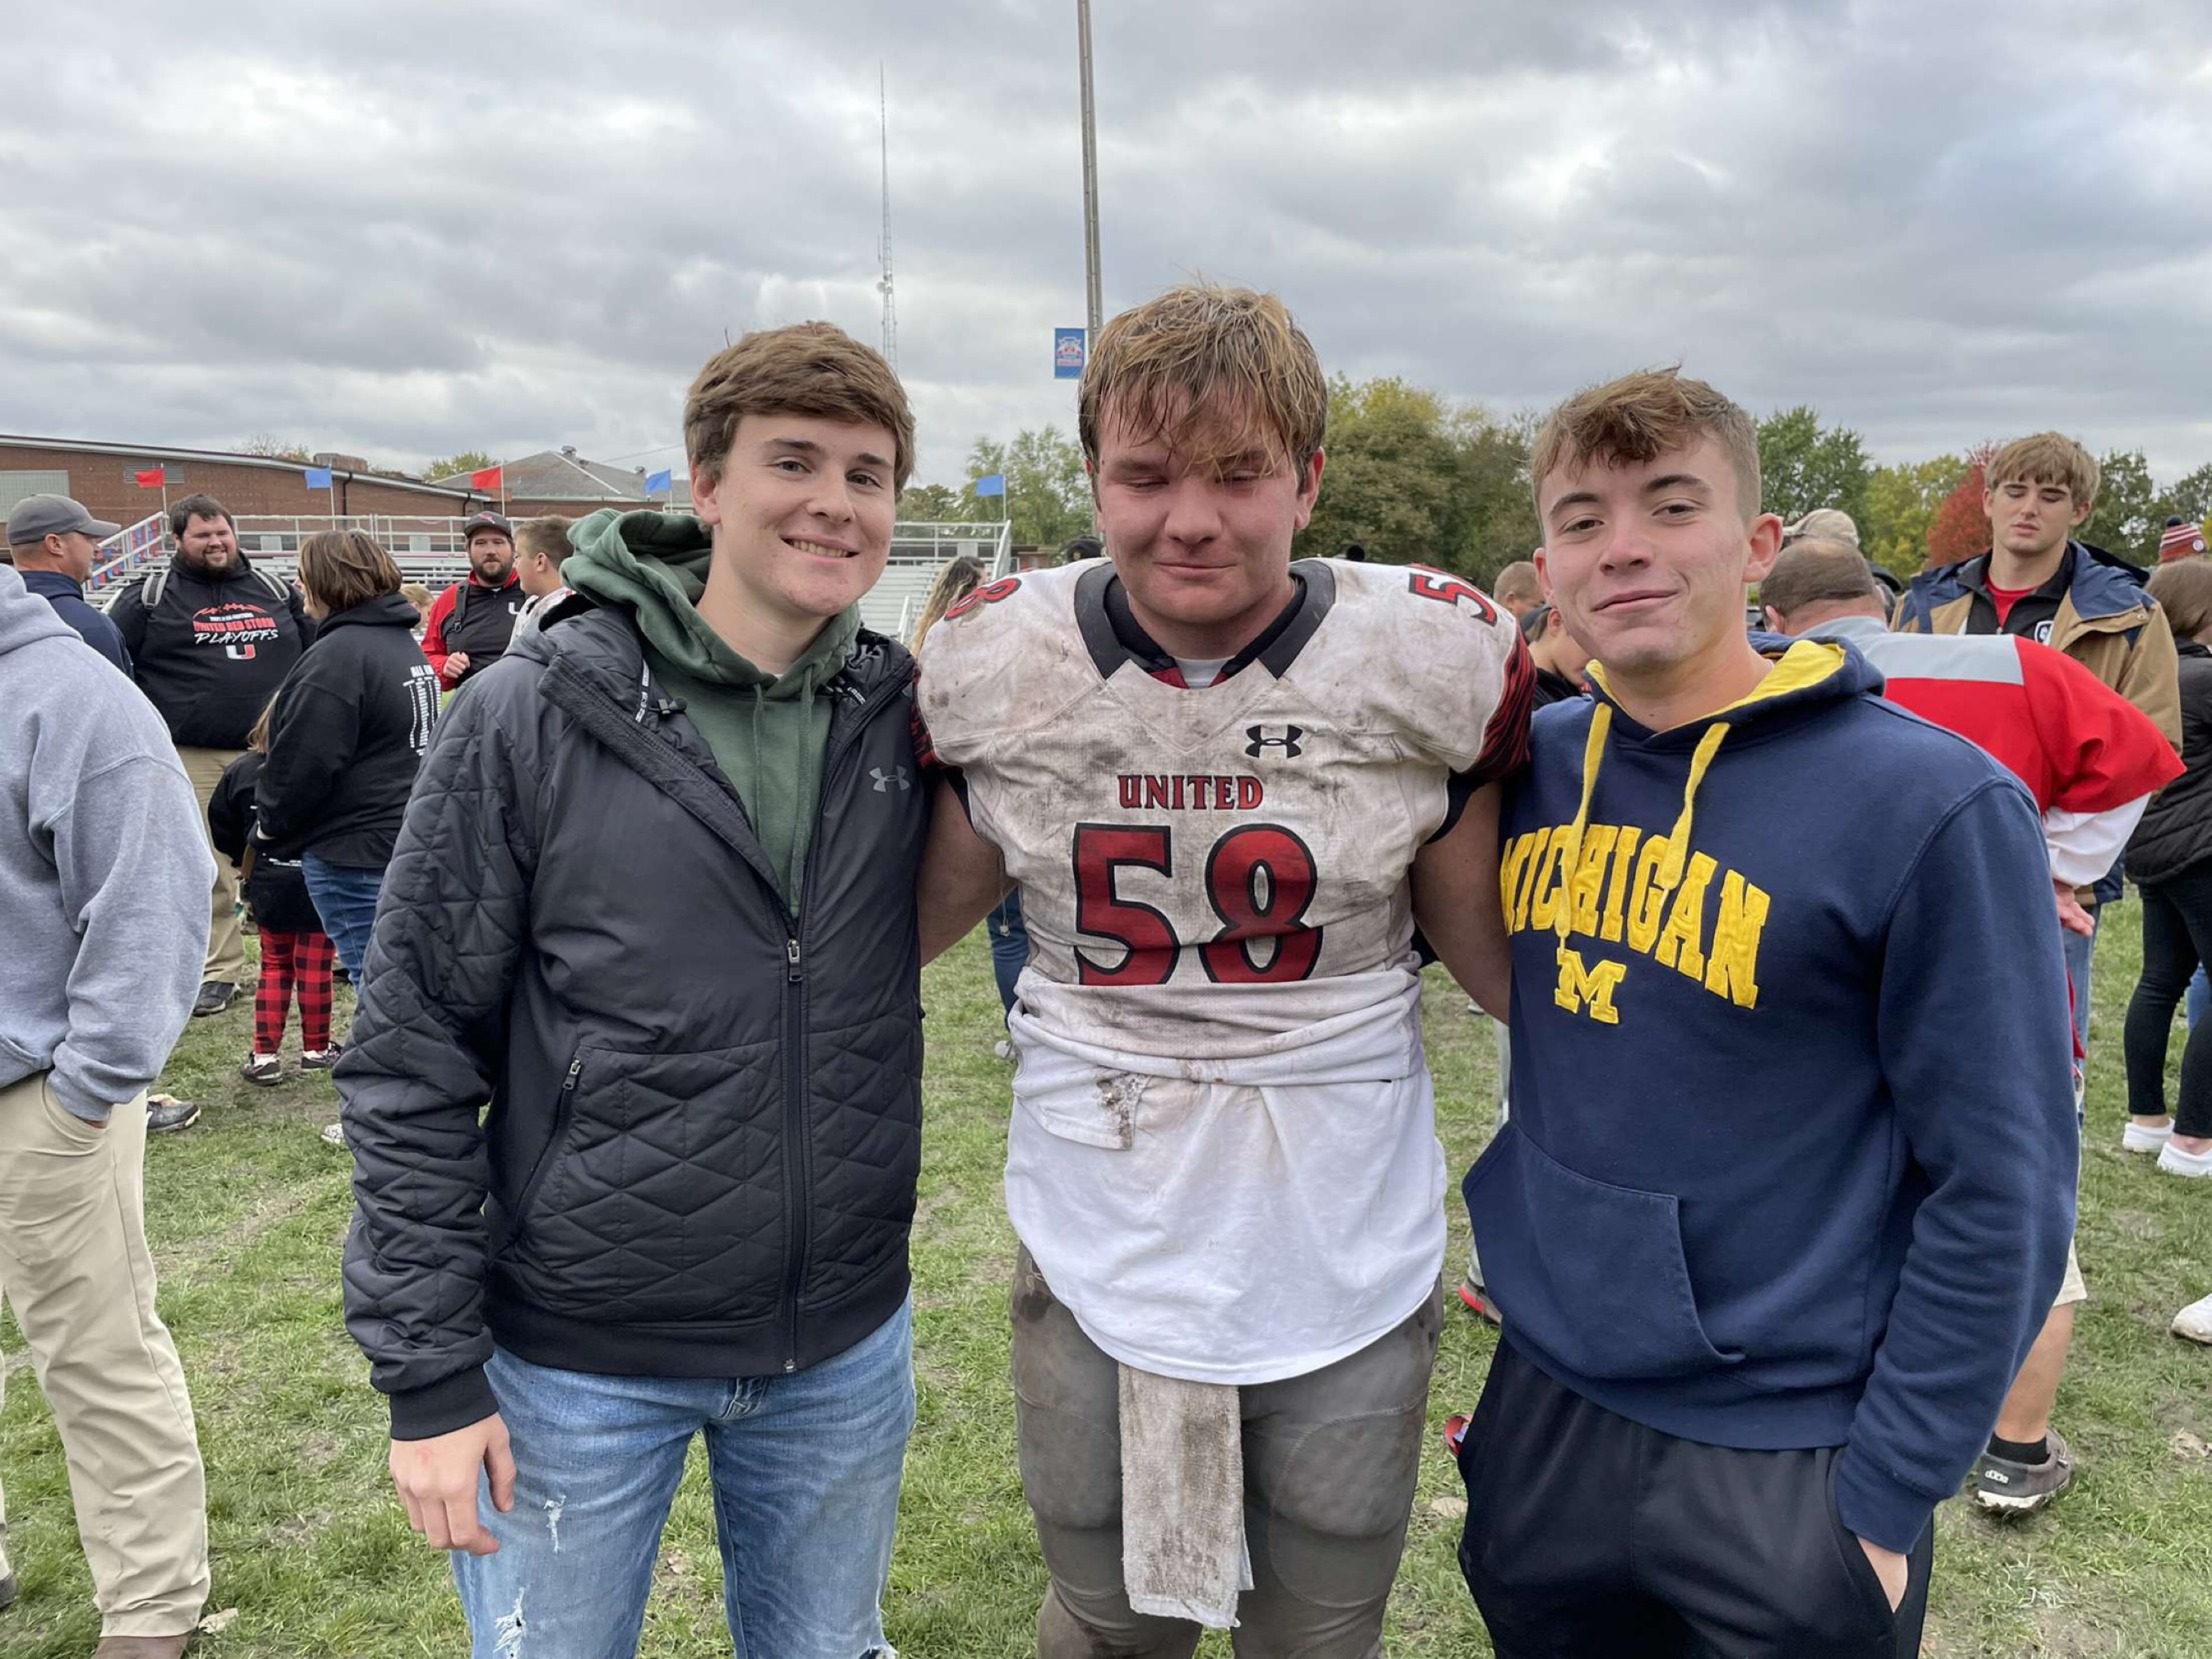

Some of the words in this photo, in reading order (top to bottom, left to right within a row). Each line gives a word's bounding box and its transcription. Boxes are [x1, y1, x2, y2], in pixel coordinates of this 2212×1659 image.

[193, 630, 279, 644] PLAYOFFS
[225, 644, 256, 660] U
[1118, 774, 1263, 811] UNITED
[1072, 822, 1323, 986] 58
[1499, 824, 1771, 1010] MICHIGAN
[1554, 947, 1628, 1025] M
